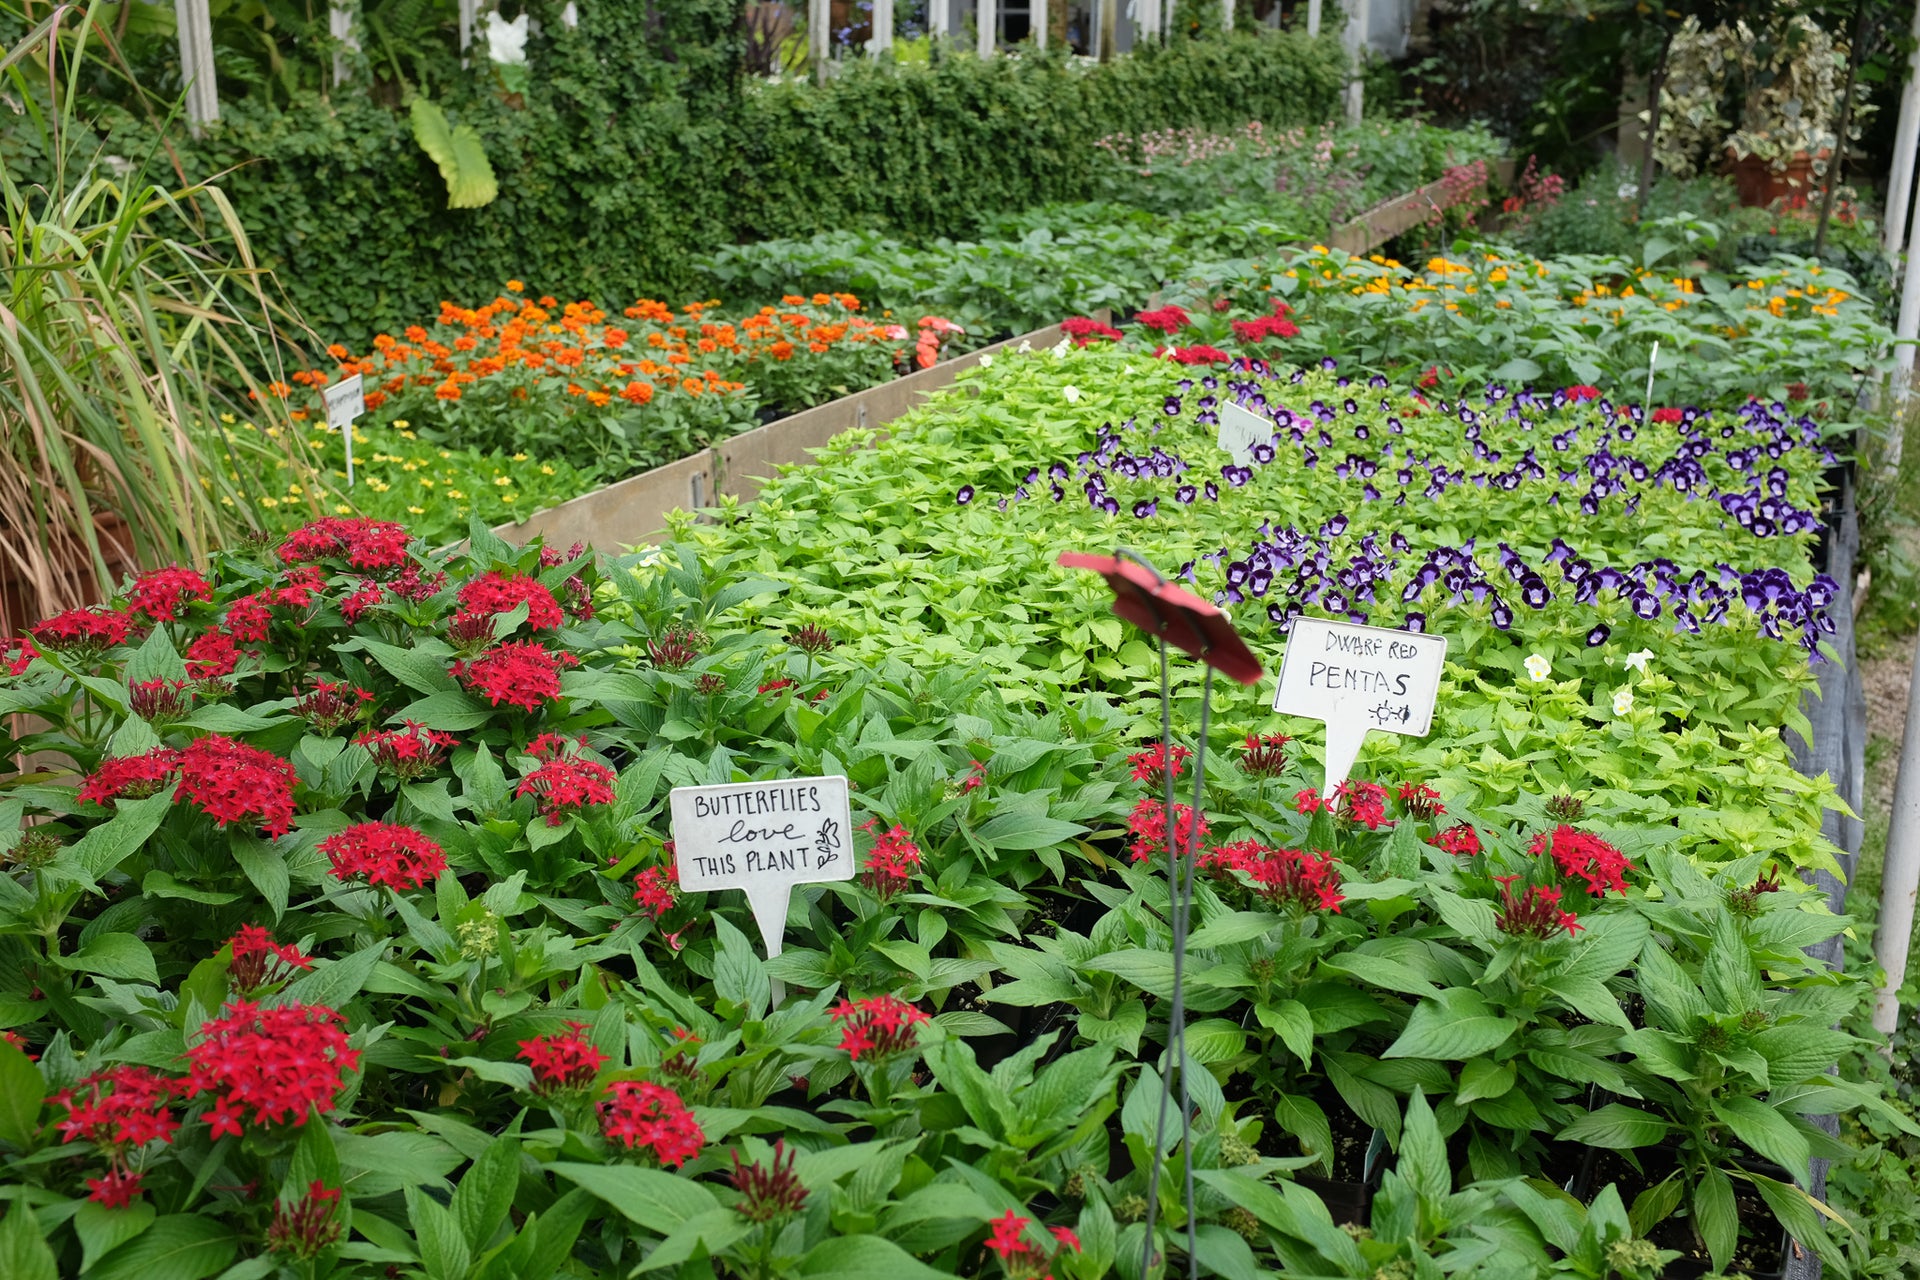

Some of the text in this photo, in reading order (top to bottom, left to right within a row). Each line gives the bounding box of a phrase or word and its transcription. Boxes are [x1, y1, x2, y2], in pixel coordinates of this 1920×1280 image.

[1325, 630, 1418, 659] DWARF RED
[1309, 661, 1411, 696] PENTAS
[695, 786, 821, 818] BUTTERFLIES
[718, 819, 806, 843] love
[692, 847, 809, 877] THIS PLANT
